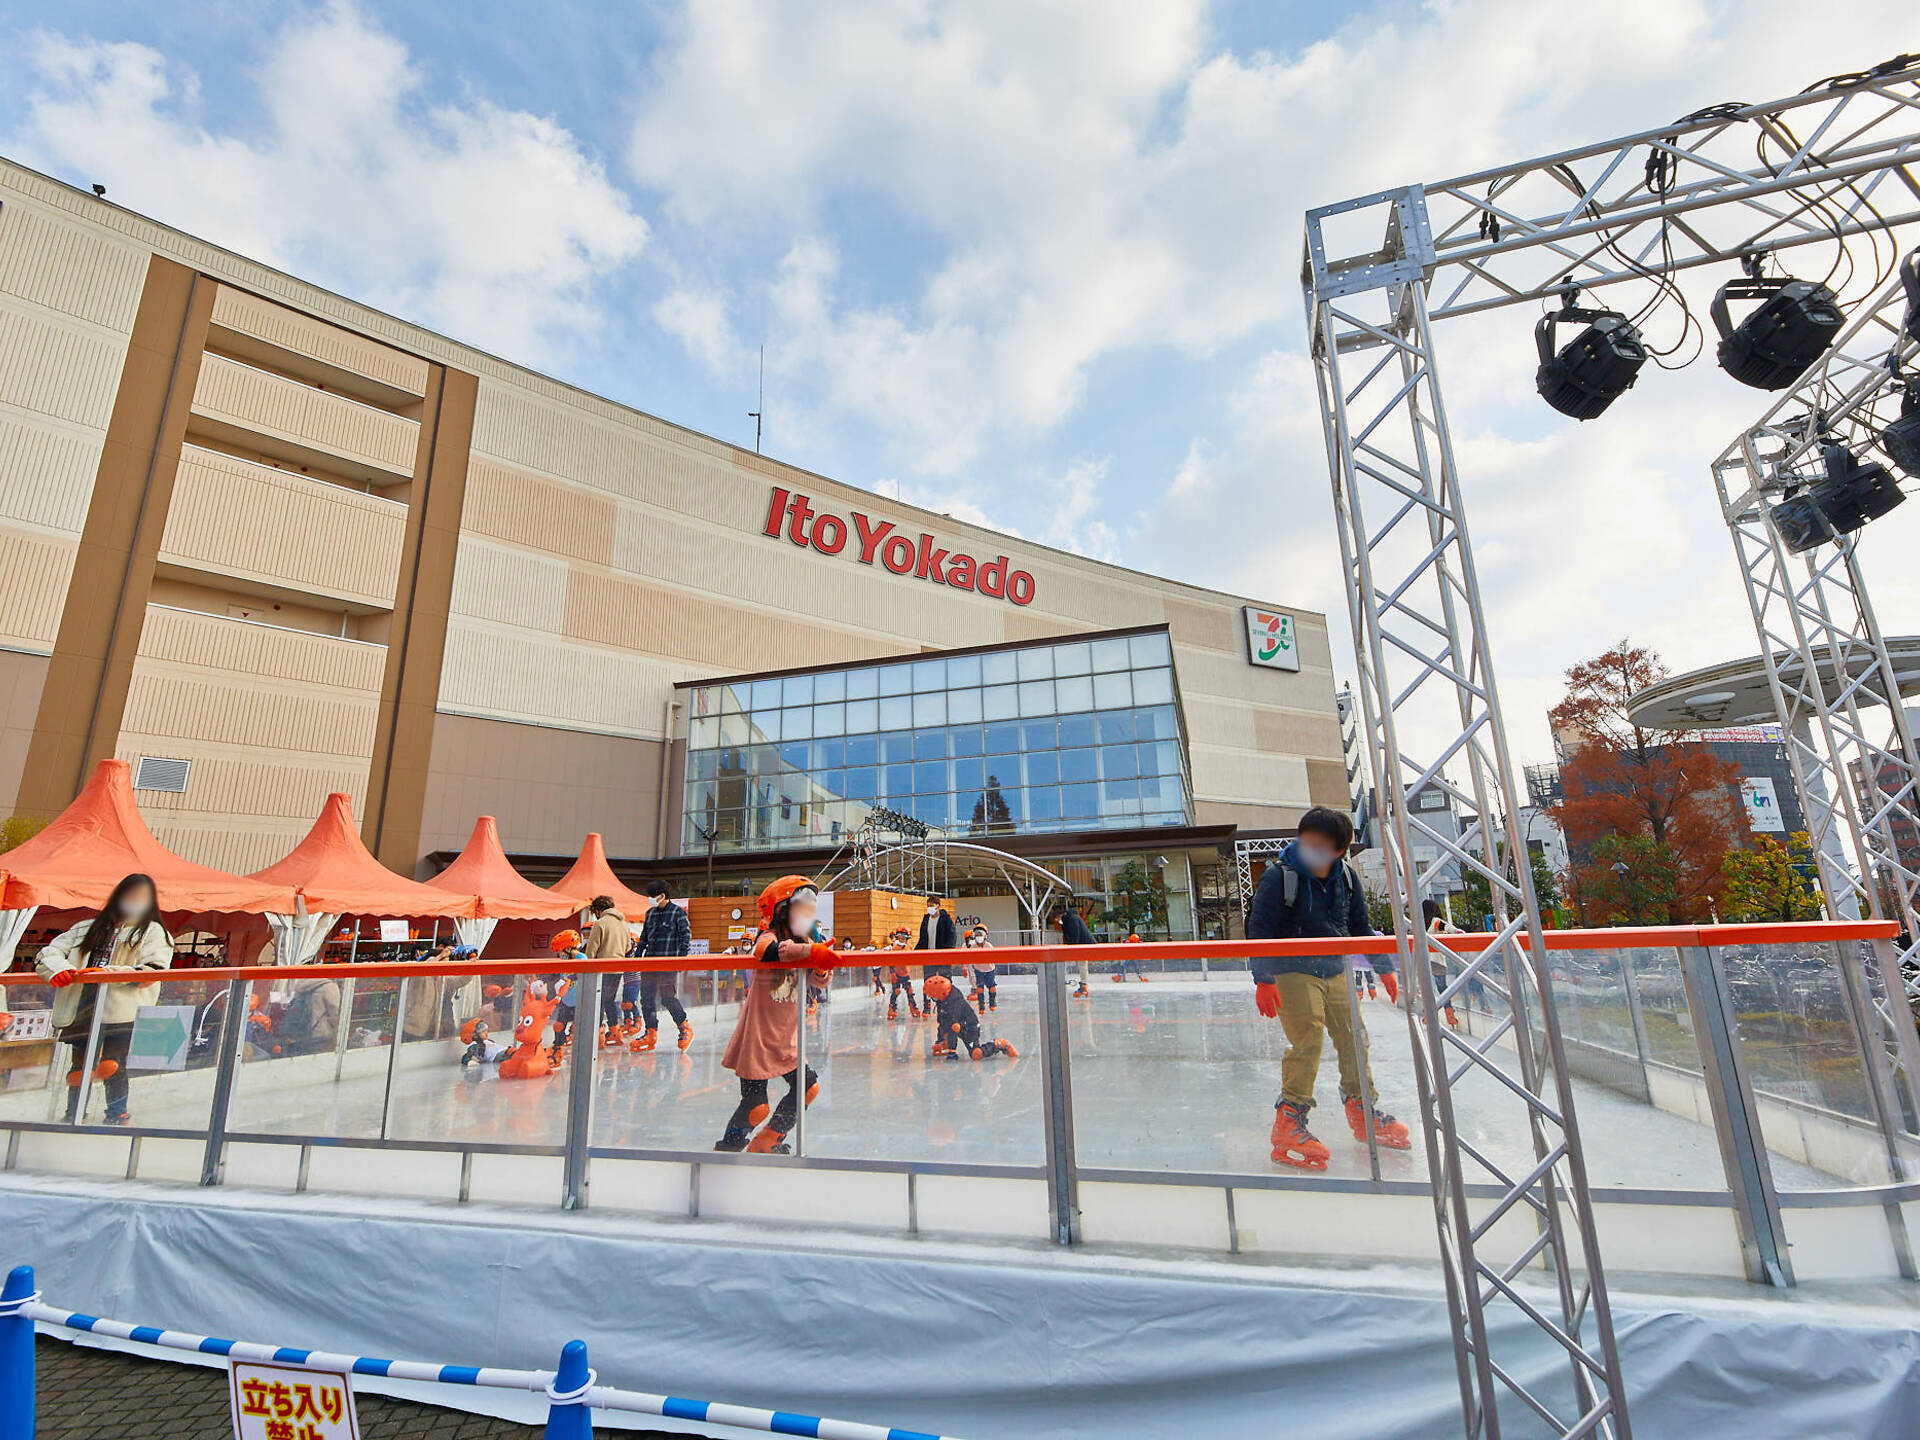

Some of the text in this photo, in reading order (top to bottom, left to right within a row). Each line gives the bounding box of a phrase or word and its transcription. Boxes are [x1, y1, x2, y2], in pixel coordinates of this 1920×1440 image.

[763, 486, 1036, 606] Ito Yokado
[955, 915, 981, 926] Ario
[241, 1377, 343, 1426] 立ち入り
